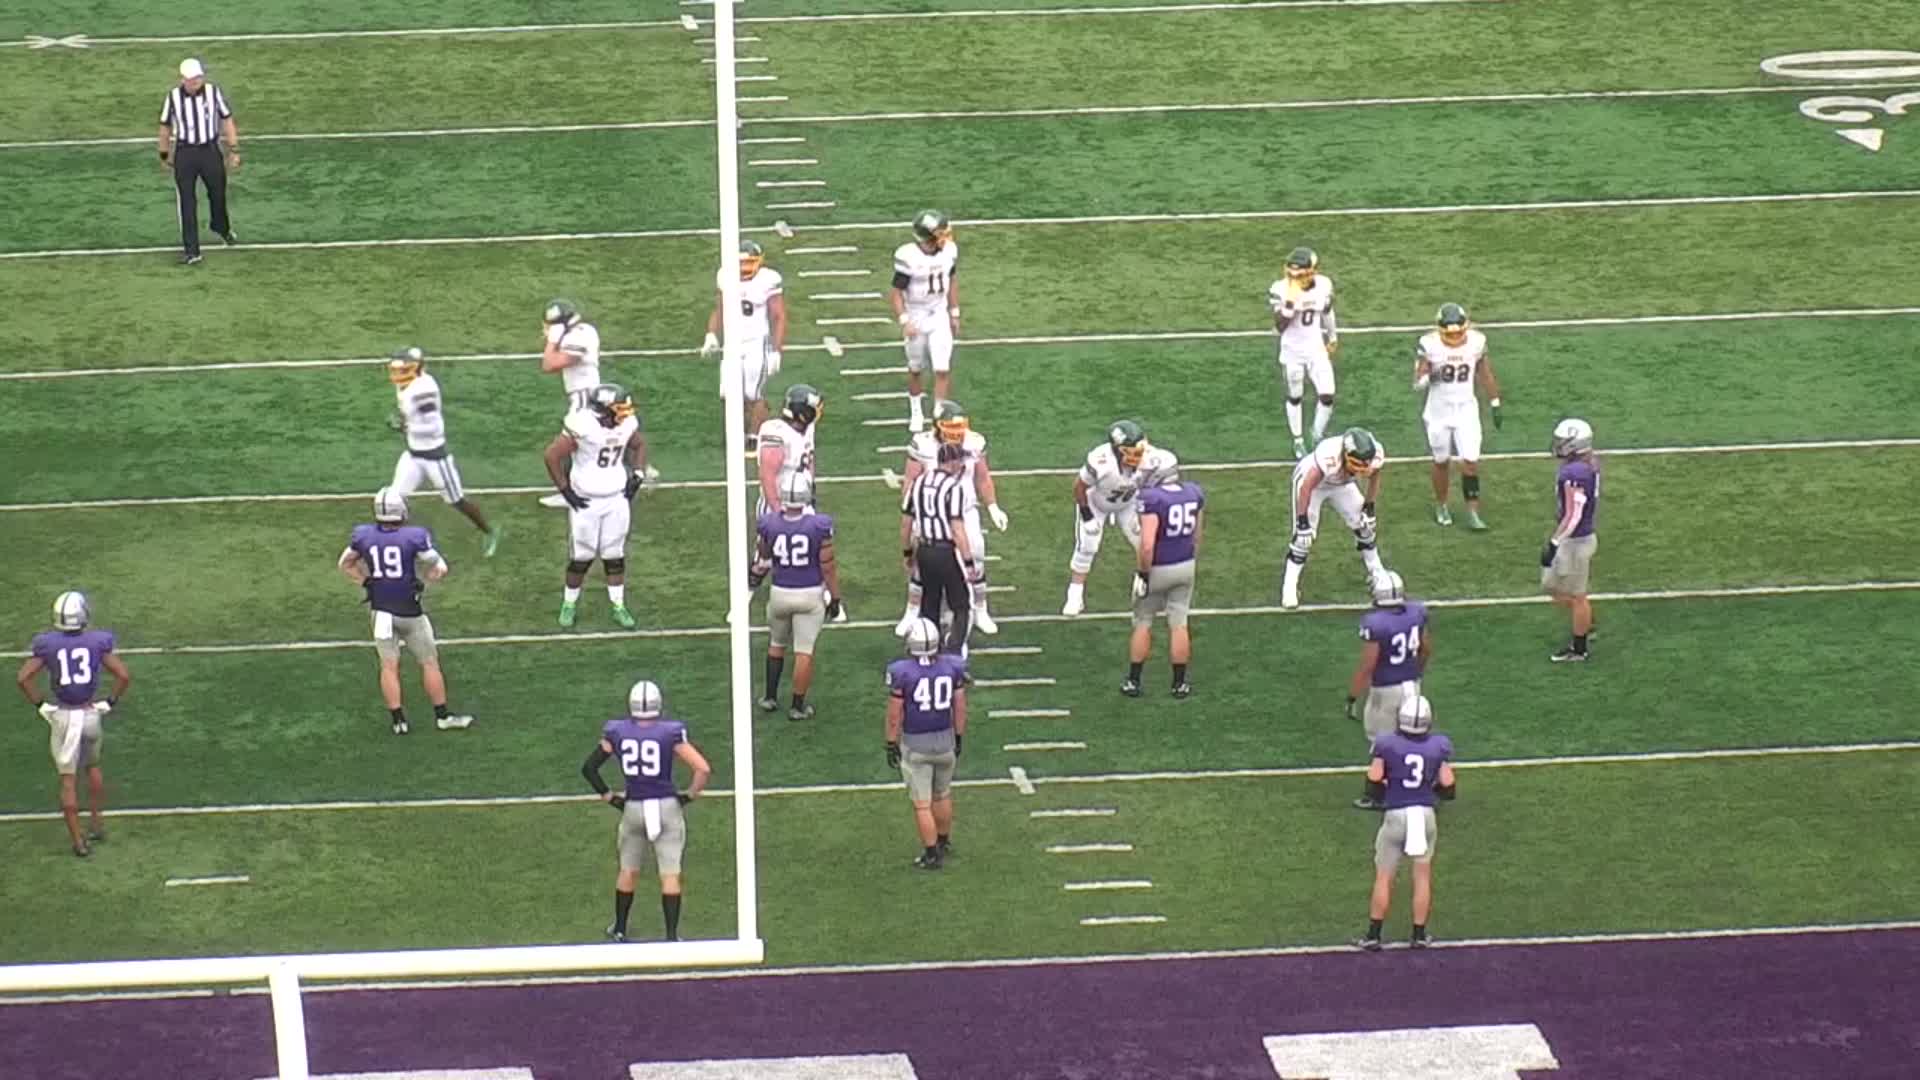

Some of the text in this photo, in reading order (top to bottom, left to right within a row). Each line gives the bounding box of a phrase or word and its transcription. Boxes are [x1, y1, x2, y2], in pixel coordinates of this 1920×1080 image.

[928, 271, 945, 295] 11
[597, 446, 620, 469] 67
[1167, 501, 1199, 536] 95
[369, 545, 403, 578] 19
[772, 534, 809, 567] 42
[1390, 625, 1420, 665] 34
[57, 647, 92, 686] 13
[913, 675, 953, 711] 40
[621, 738, 661, 776] 29
[1403, 753, 1424, 788] 3
